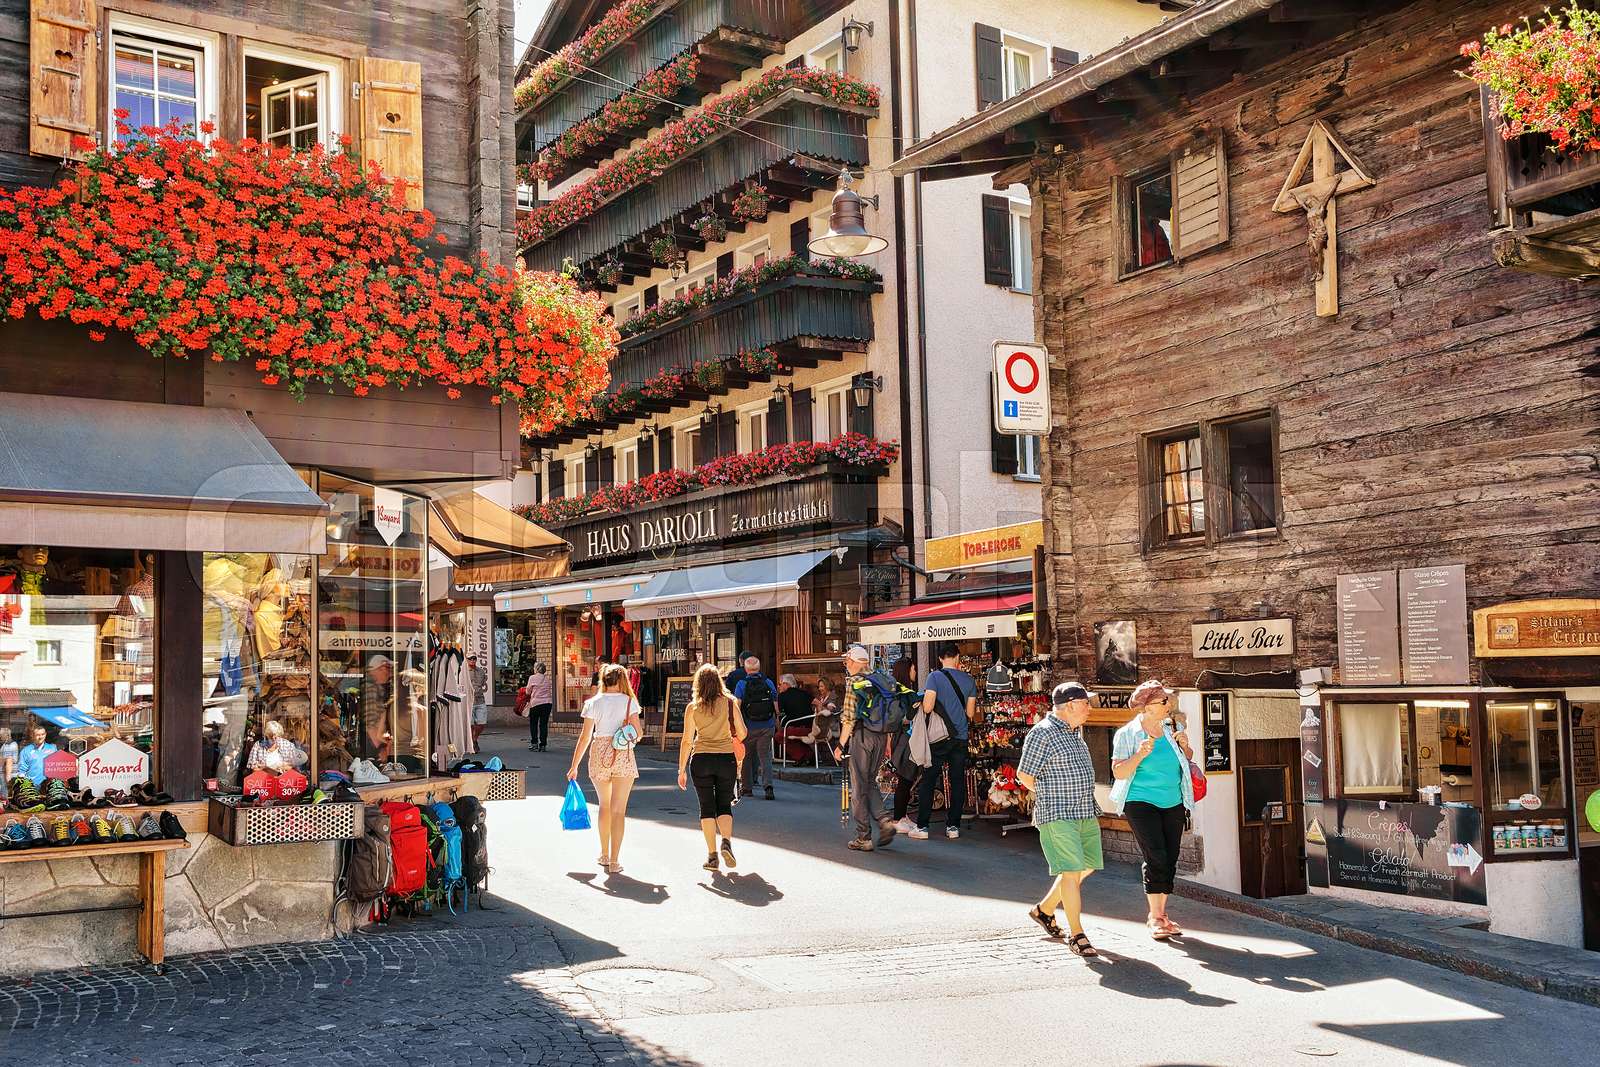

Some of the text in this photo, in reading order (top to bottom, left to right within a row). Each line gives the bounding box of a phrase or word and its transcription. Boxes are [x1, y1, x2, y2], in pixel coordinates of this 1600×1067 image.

[376, 505, 401, 528] Bayard
[731, 500, 831, 532] Zermatterstübli
[587, 508, 717, 557] HAUS DARIOLI
[963, 536, 1022, 560] TOBLERONE
[1530, 615, 1584, 629] Stefanie's
[899, 627, 921, 640] Tabak
[928, 624, 967, 638] Souvenirs
[1199, 626, 1285, 651] Little Bar
[84, 757, 144, 780] Bayard
[246, 780, 272, 789] SALE
[279, 778, 304, 788] SALE
[282, 787, 301, 796] 30%
[1431, 868, 1457, 881] Product
